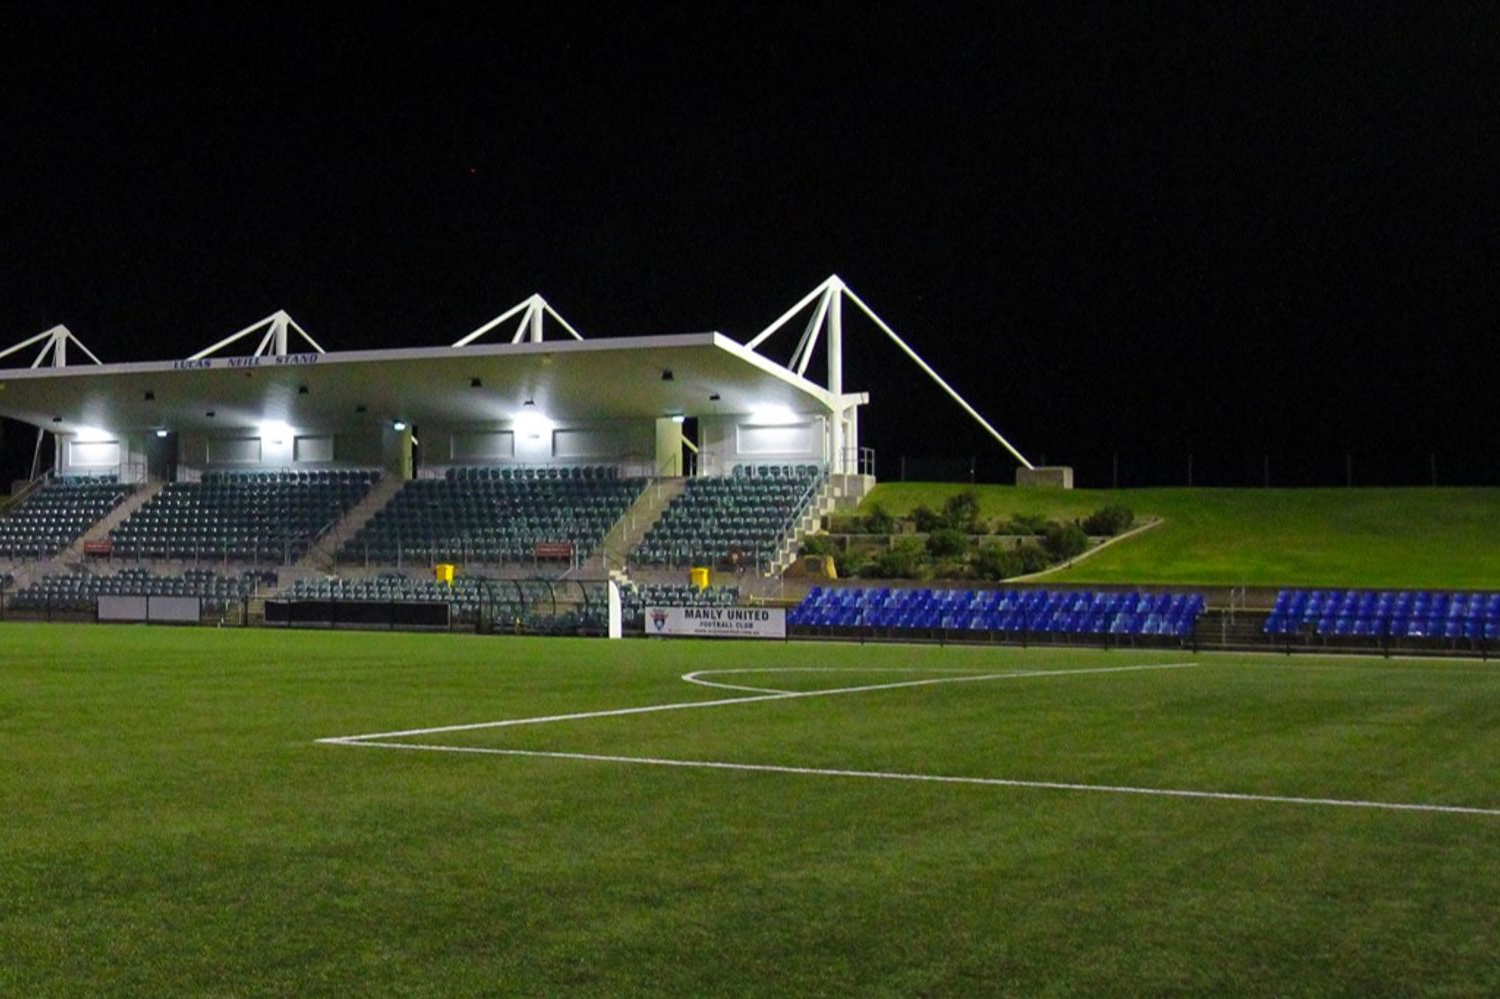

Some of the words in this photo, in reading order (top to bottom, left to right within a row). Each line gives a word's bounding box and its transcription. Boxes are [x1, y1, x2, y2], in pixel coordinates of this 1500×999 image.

[173, 359, 211, 369] LUCAS
[227, 357, 260, 367] NEILL
[275, 354, 318, 365] STAND
[684, 609, 723, 620] MANLY
[727, 610, 770, 621] UNITED
[699, 621, 733, 629] FOOTBALL
